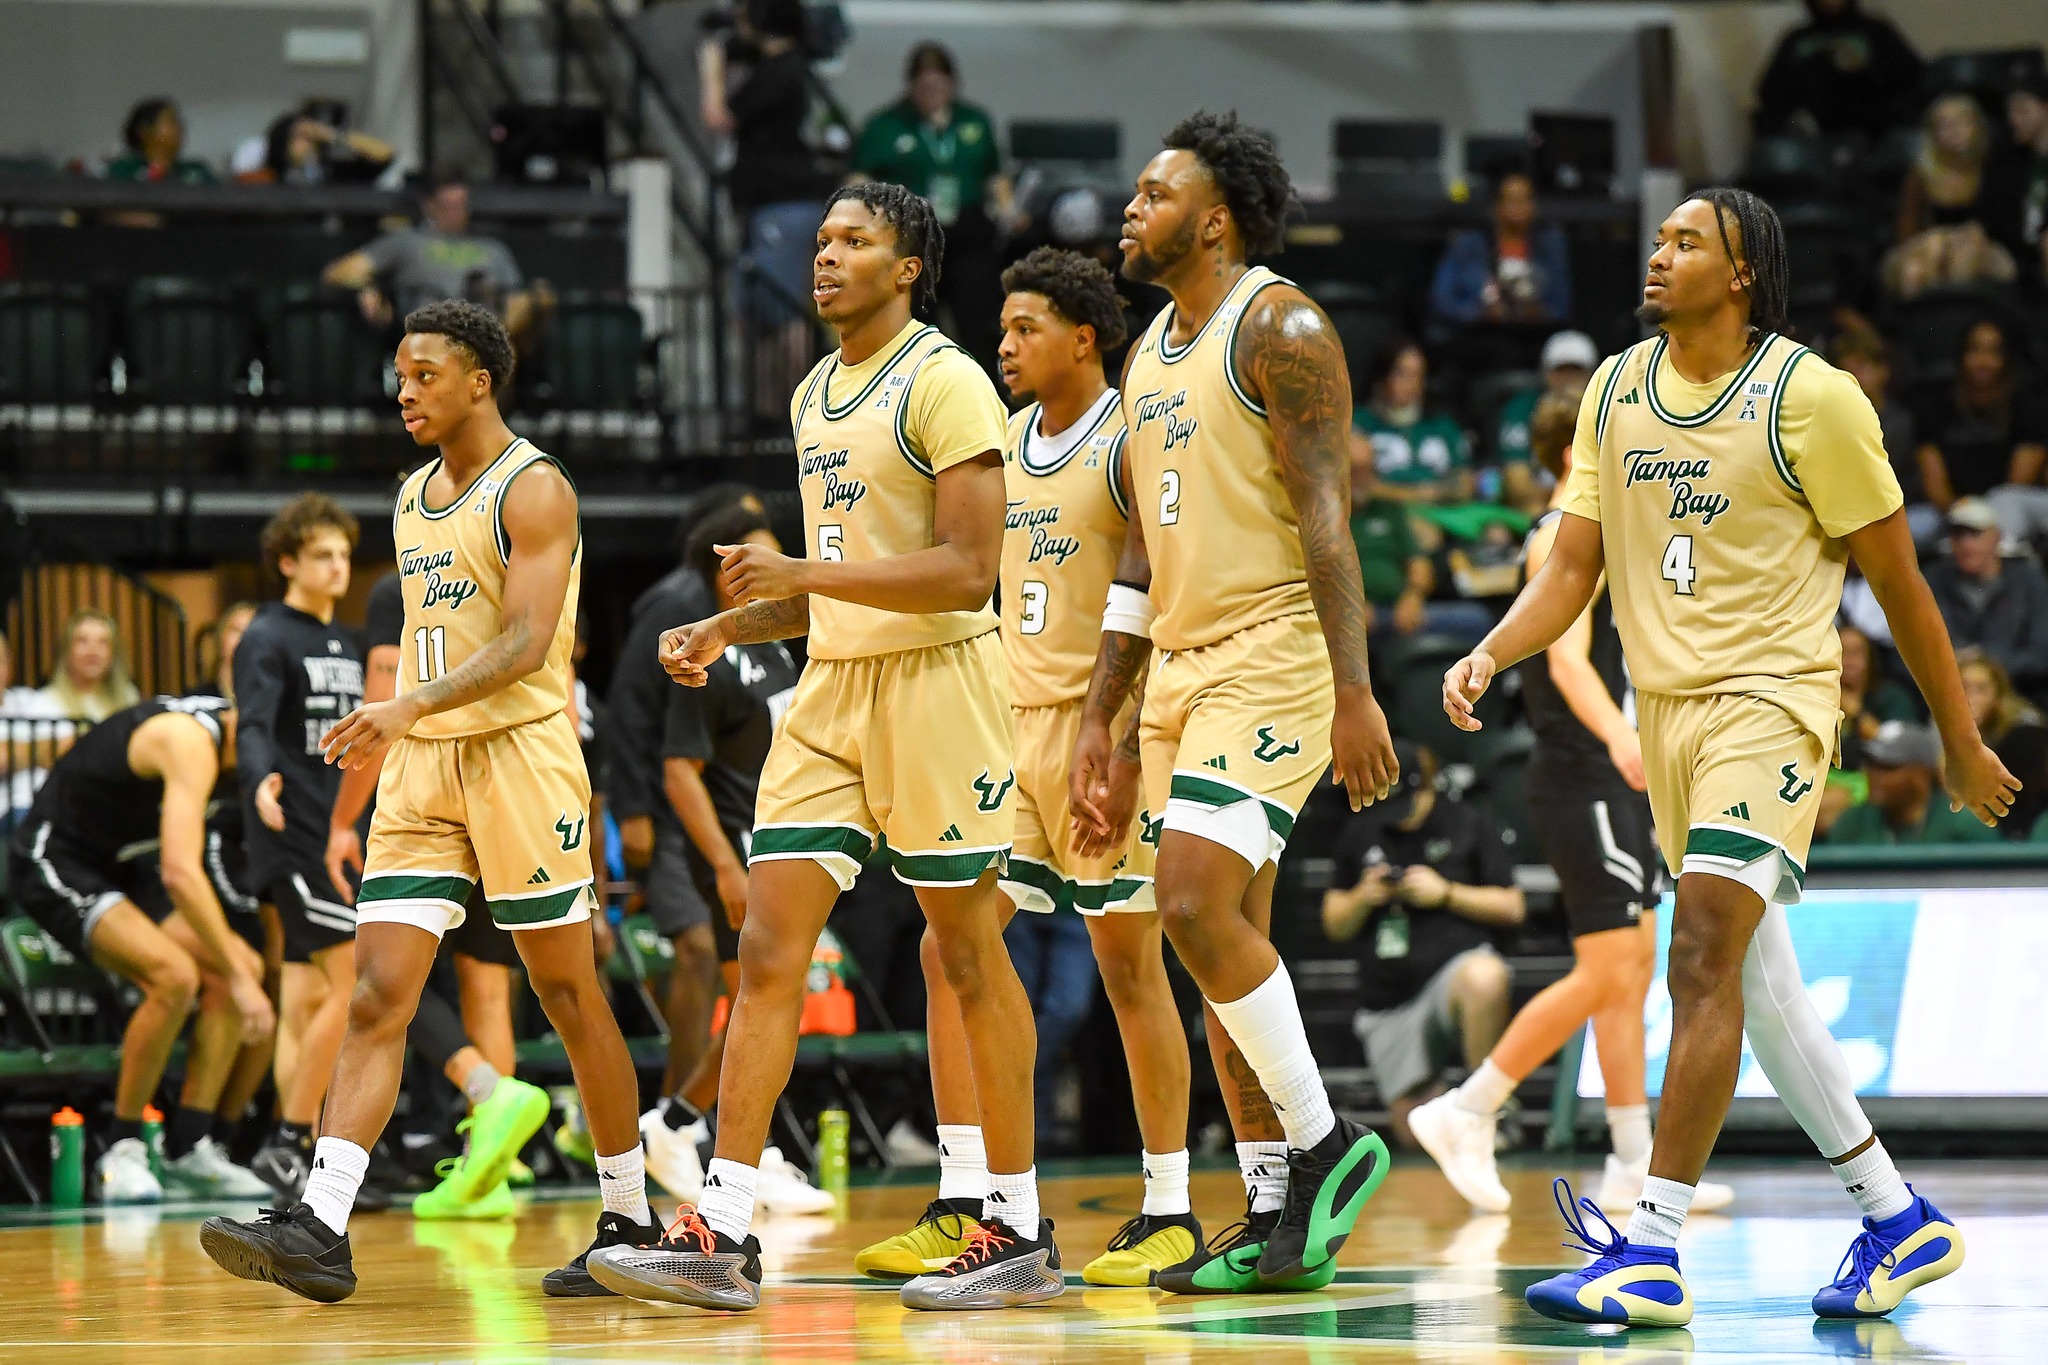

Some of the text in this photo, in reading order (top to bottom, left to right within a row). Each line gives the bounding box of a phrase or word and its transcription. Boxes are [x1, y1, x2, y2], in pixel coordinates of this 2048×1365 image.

[1134, 388, 1187, 432] Tampa
[1749, 383, 1768, 396] AAR
[1163, 414, 1198, 451] Bay
[799, 443, 849, 486] Tampa
[1623, 446, 1710, 489] Tampa
[822, 472, 867, 512] Bay
[1158, 468, 1181, 527] 2
[1668, 481, 1730, 526] Bay
[1005, 499, 1060, 534] Tampa
[400, 544, 454, 580] Tampa
[817, 523, 844, 562] 5
[1028, 528, 1080, 566] Bay
[1661, 534, 1696, 596] 4
[421, 572, 479, 610] Bay
[1020, 579, 1049, 636] 3
[414, 625, 448, 683] 11
